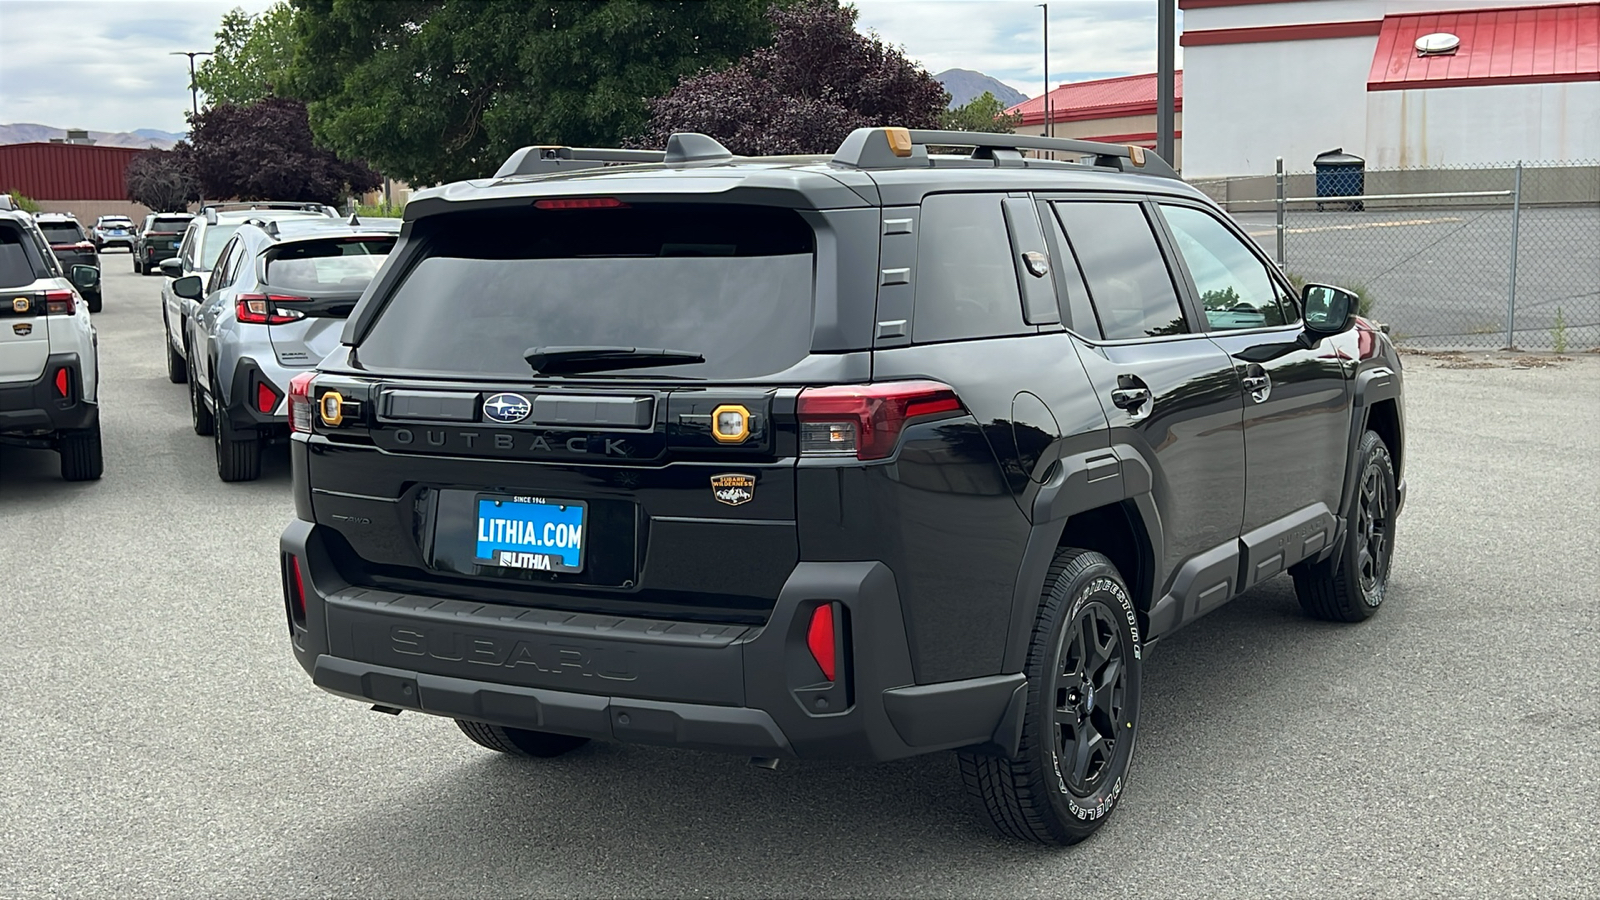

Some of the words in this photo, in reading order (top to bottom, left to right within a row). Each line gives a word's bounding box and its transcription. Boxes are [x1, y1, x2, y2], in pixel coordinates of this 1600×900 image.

[393, 429, 628, 455] OUTBACK
[513, 495, 532, 504] SINCE
[477, 517, 583, 550] LITHIA.COM
[511, 552, 551, 570] LITHIA
[390, 624, 639, 682] SUBARU
[1068, 776, 1122, 821] DUELER
